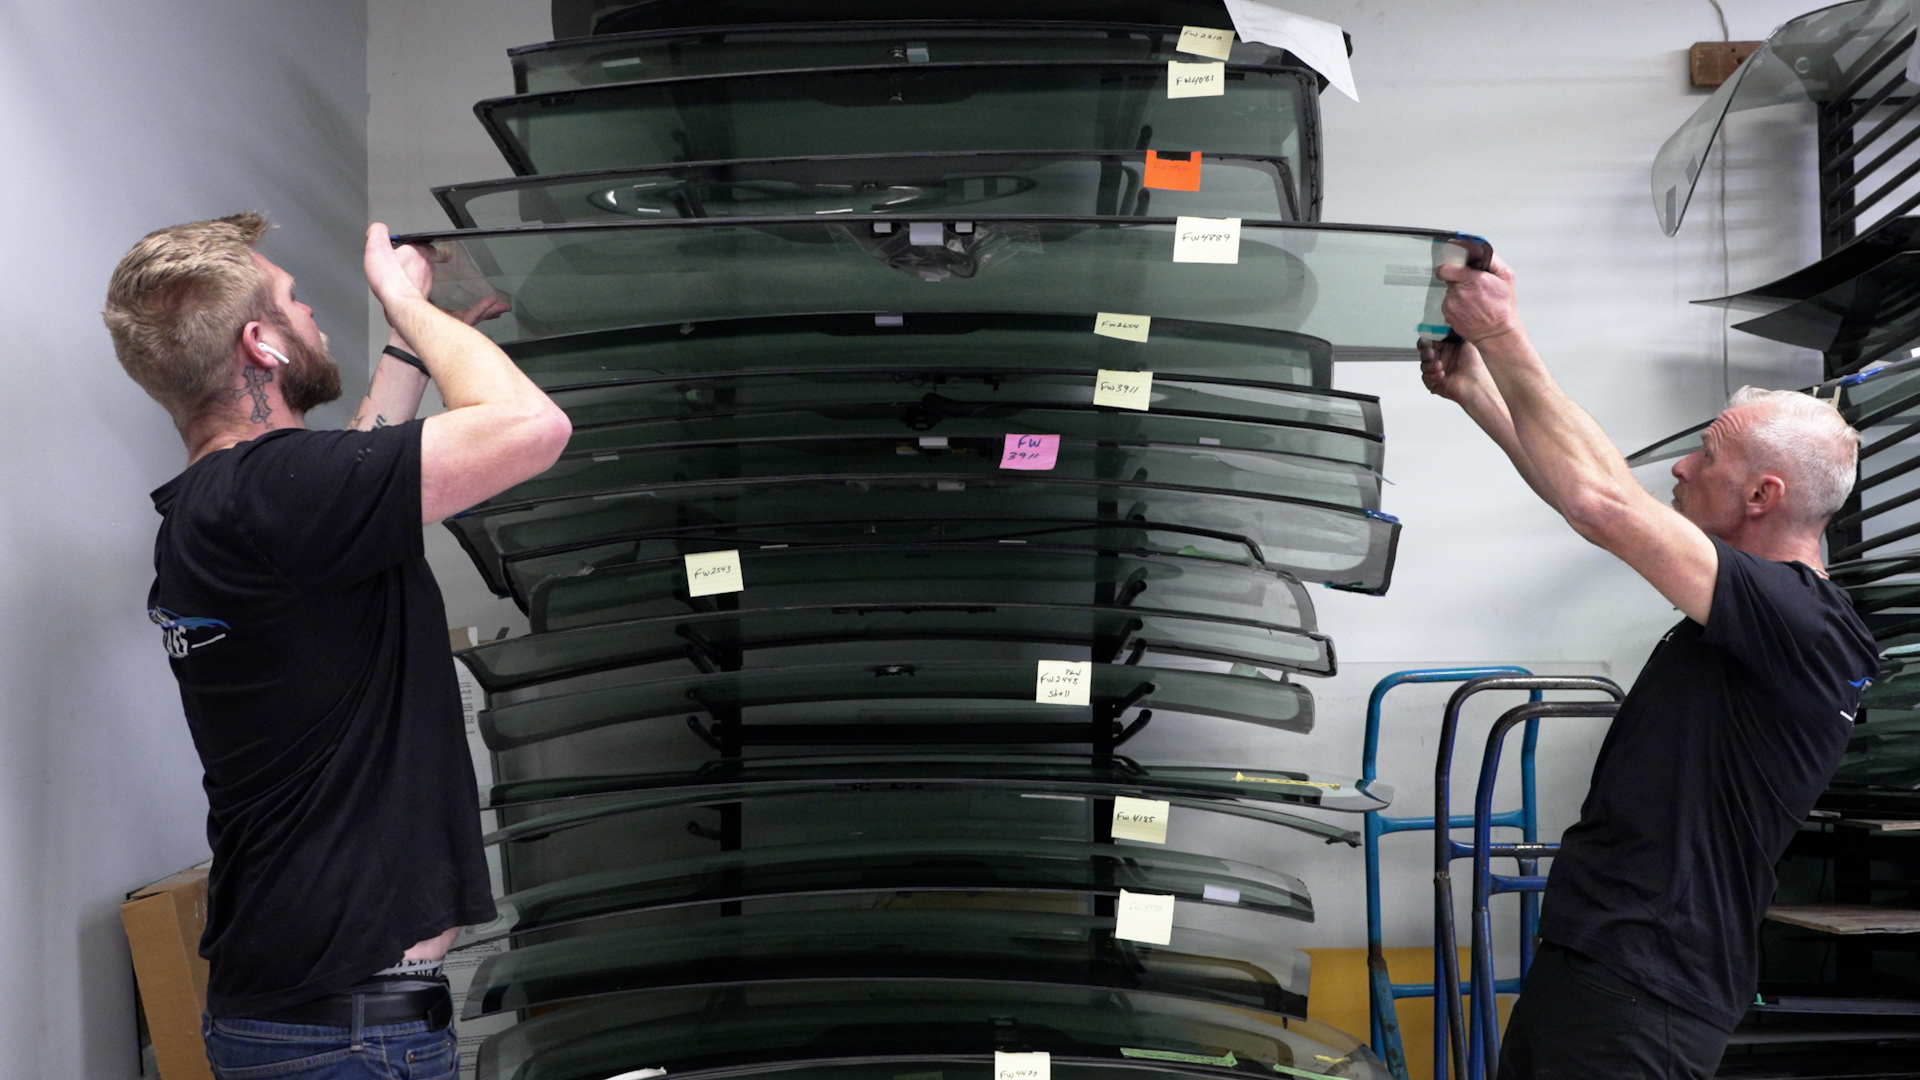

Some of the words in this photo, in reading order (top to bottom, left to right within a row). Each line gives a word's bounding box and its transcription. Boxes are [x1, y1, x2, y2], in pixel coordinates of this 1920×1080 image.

[1176, 75, 1215, 86] FW4081
[1182, 232, 1231, 243] FW4889
[1100, 381, 1140, 394] FW3911
[1017, 434, 1042, 449] FW
[1007, 451, 1040, 461] 3911
[694, 566, 732, 579] FW2543
